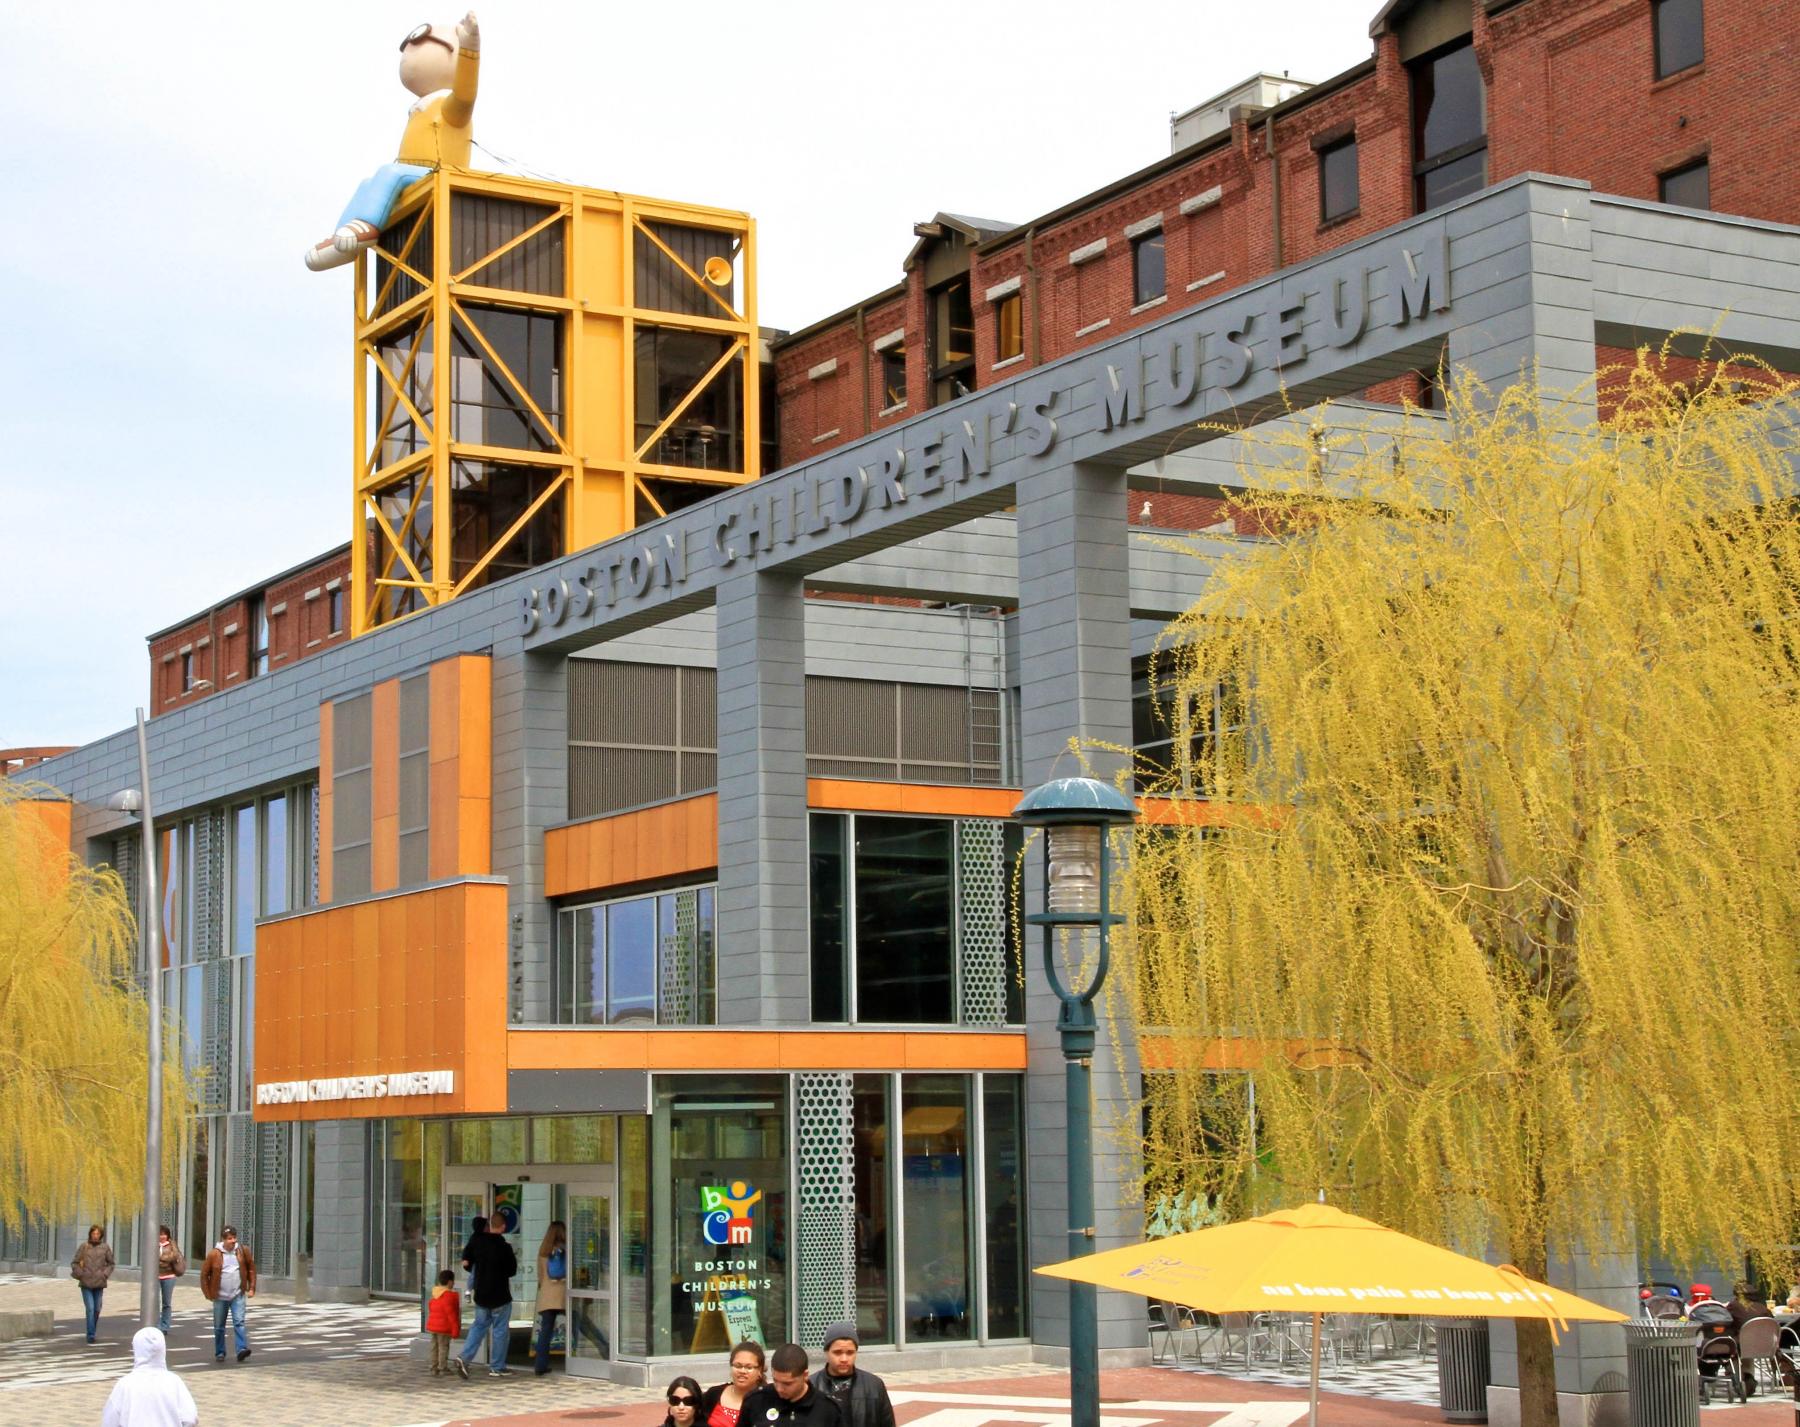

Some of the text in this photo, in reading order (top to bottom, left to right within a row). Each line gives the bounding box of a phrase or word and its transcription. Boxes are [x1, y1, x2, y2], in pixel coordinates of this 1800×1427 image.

[519, 235, 1451, 637] BOSTON CHILDREN'S MUSEUM
[694, 1259, 757, 1272] BOSTON
[682, 1279, 771, 1293] CHILDREN'S
[1261, 1285, 1294, 1296] au
[1294, 1283, 1347, 1297] bon
[1349, 1285, 1406, 1300] pain
[1409, 1289, 1442, 1299] au
[1441, 1286, 1495, 1300] bon
[694, 1300, 757, 1312] MUSEUM
